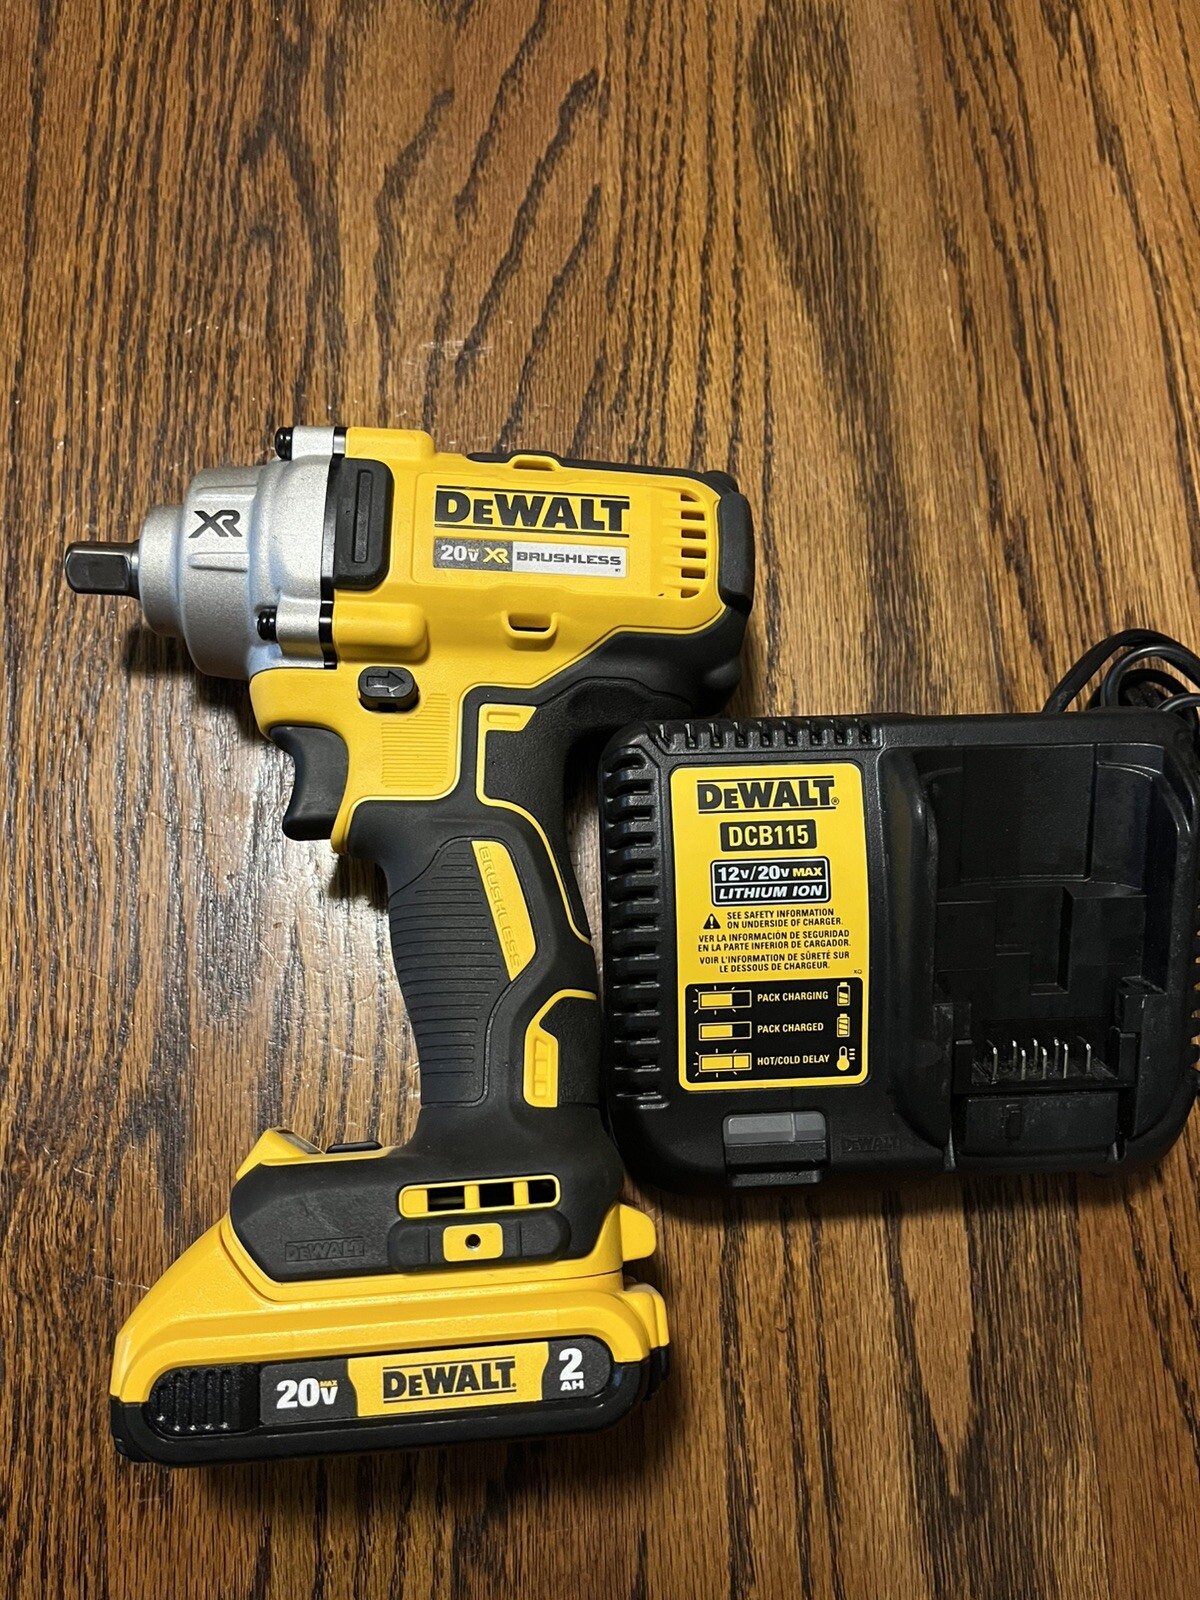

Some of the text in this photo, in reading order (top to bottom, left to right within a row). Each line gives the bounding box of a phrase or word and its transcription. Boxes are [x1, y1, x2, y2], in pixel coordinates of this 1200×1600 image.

[434, 490, 630, 532] DEWALT
[189, 509, 242, 538] XR
[482, 547, 510, 564] XR
[516, 551, 622, 567] BRUSHLESS
[728, 825, 809, 847] DCB115
[792, 866, 823, 877] MAX
[719, 884, 823, 900] LITHIUM ION
[479, 846, 520, 968] BRUSHLESS
[727, 908, 834, 920] SEE SAFETY INFORMATION
[727, 917, 843, 929] ON UNDERSIDE OF CHARGER.
[699, 929, 850, 943] VER LA INFORMACIÓN DE SEGURIDAD
[698, 938, 851, 952] EN LA PARTE INFERIOR DE CARGADOR.
[700, 950, 850, 964] VOIR L'INFORMATION DE SÛRETÉ SUR
[719, 961, 830, 973] LE DESSOUS DE CHARGEUR.
[757, 991, 829, 1002] PACK CHARGING
[757, 1023, 824, 1033] PACK CHARGED
[757, 1054, 830, 1066] HOT/COLD DELAY
[285, 1239, 364, 1262] DEWALT
[559, 1347, 584, 1381] 2
[560, 1379, 585, 1391] AH
